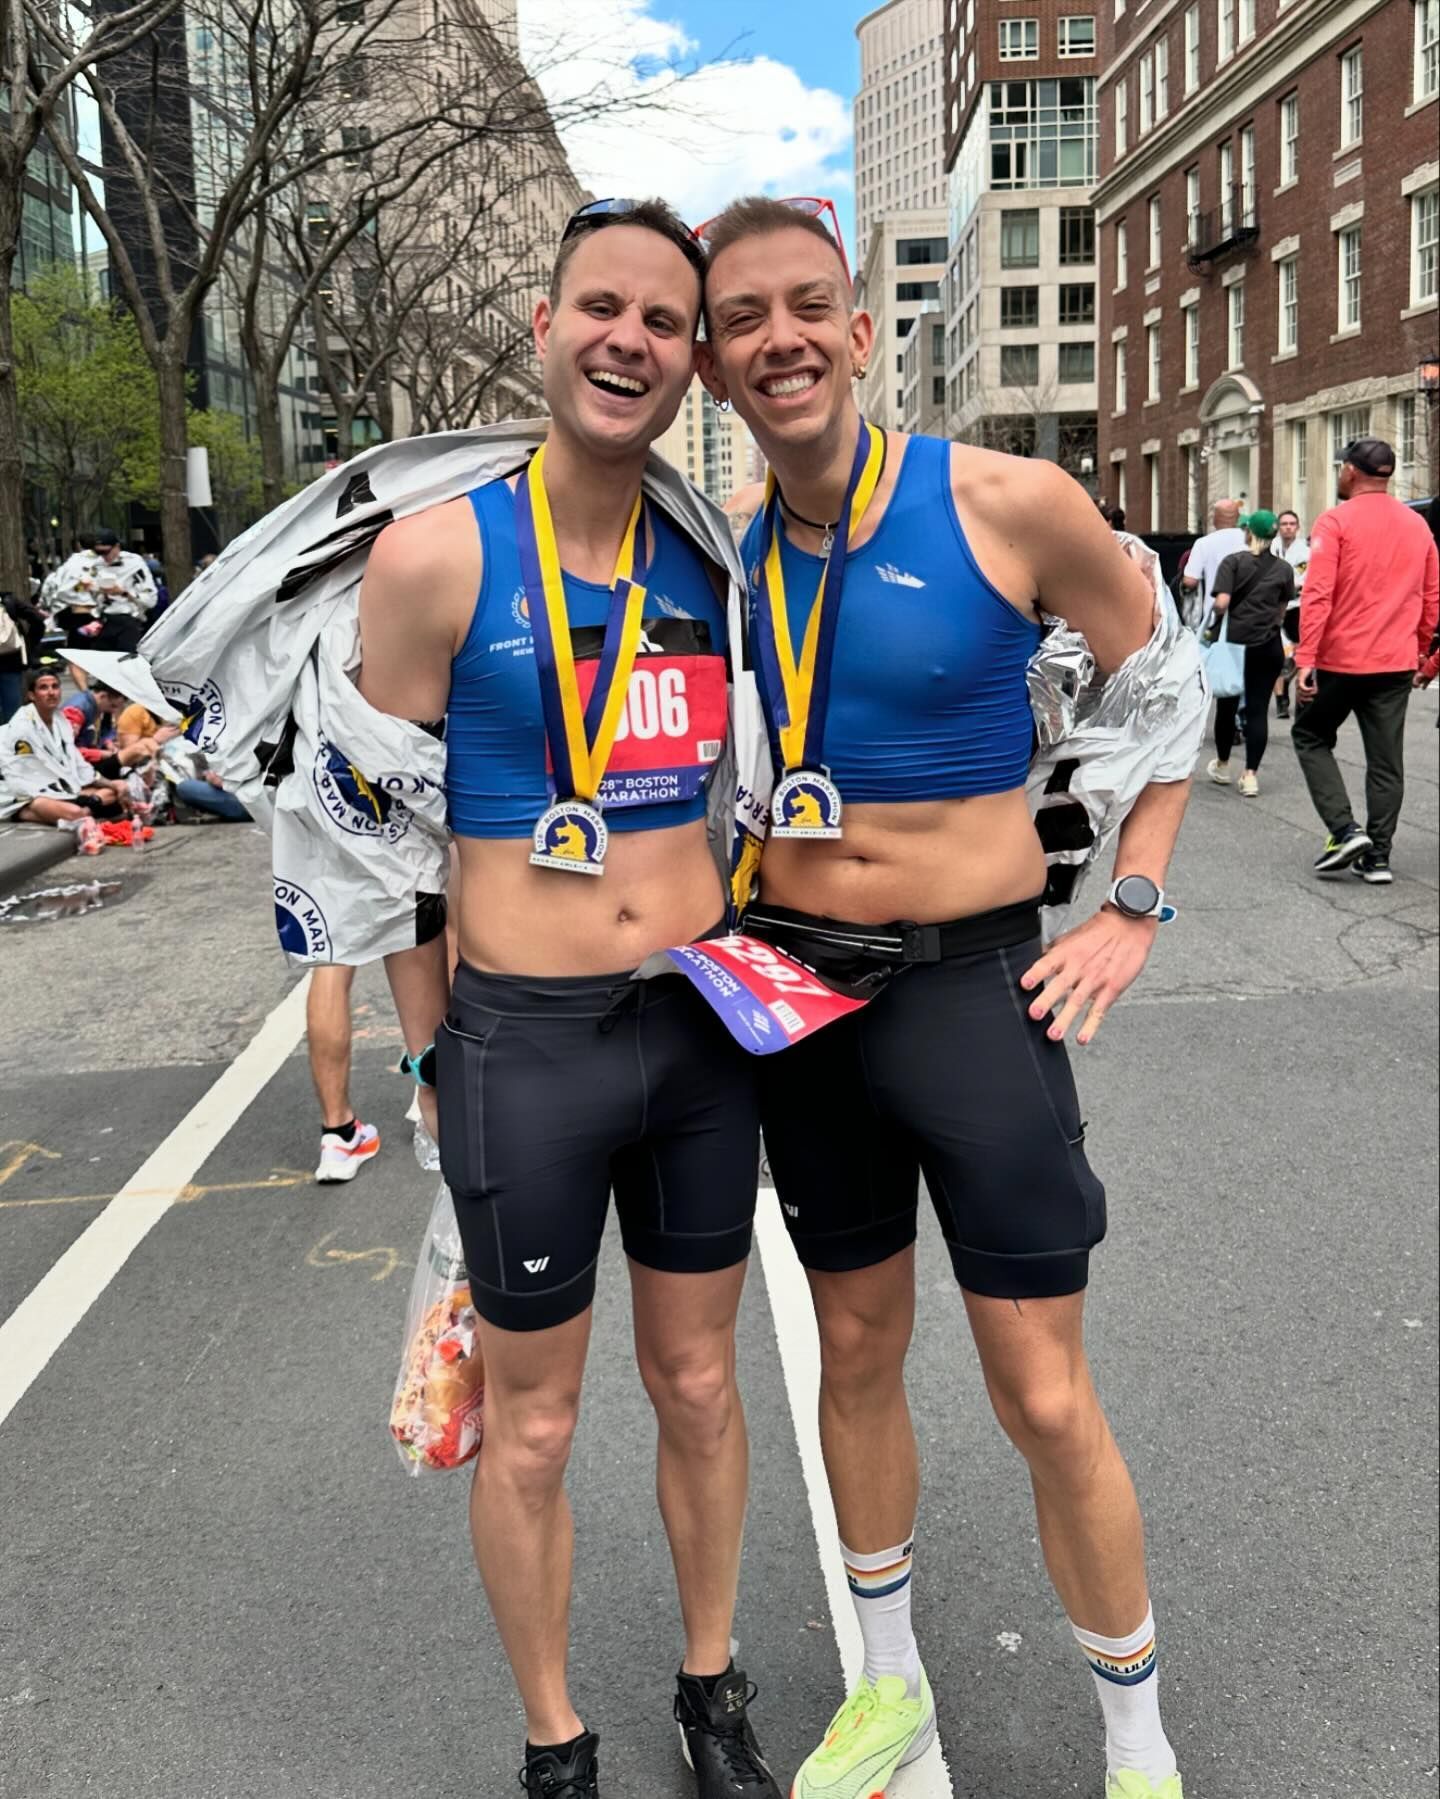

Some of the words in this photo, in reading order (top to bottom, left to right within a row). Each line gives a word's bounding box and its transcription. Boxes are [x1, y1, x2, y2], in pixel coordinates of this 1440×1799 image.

[489, 637, 528, 653] FRONT
[625, 775, 679, 789] BOSTON
[778, 776, 808, 797] BOSTON
[813, 777, 839, 821] MARATHON
[544, 806, 579, 824] BOSTON
[583, 810, 606, 858] MARATHON
[696, 954, 741, 993] BOSTON
